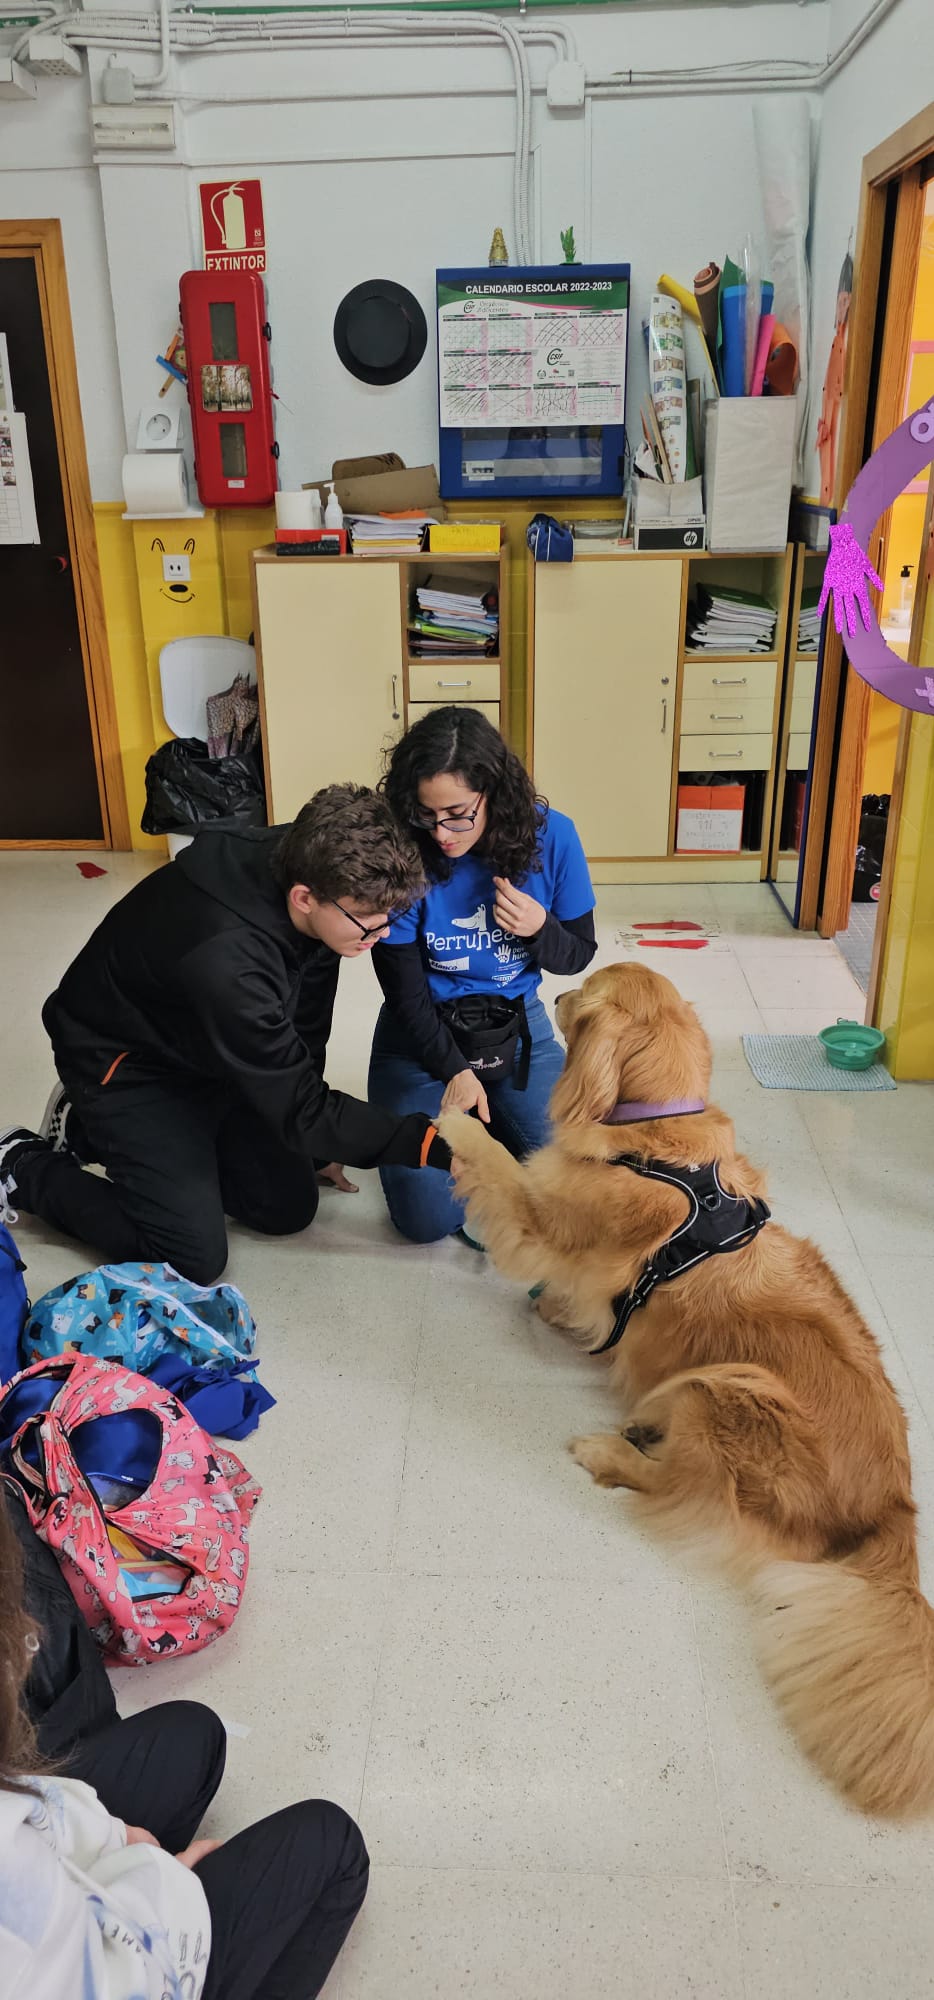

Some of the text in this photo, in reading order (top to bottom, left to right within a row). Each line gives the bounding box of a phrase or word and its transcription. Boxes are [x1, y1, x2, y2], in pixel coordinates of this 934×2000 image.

[207, 255, 265, 271] EXTINTOR
[465, 281, 612, 295] CALENDARIO ESCOLAR 2022-2023
